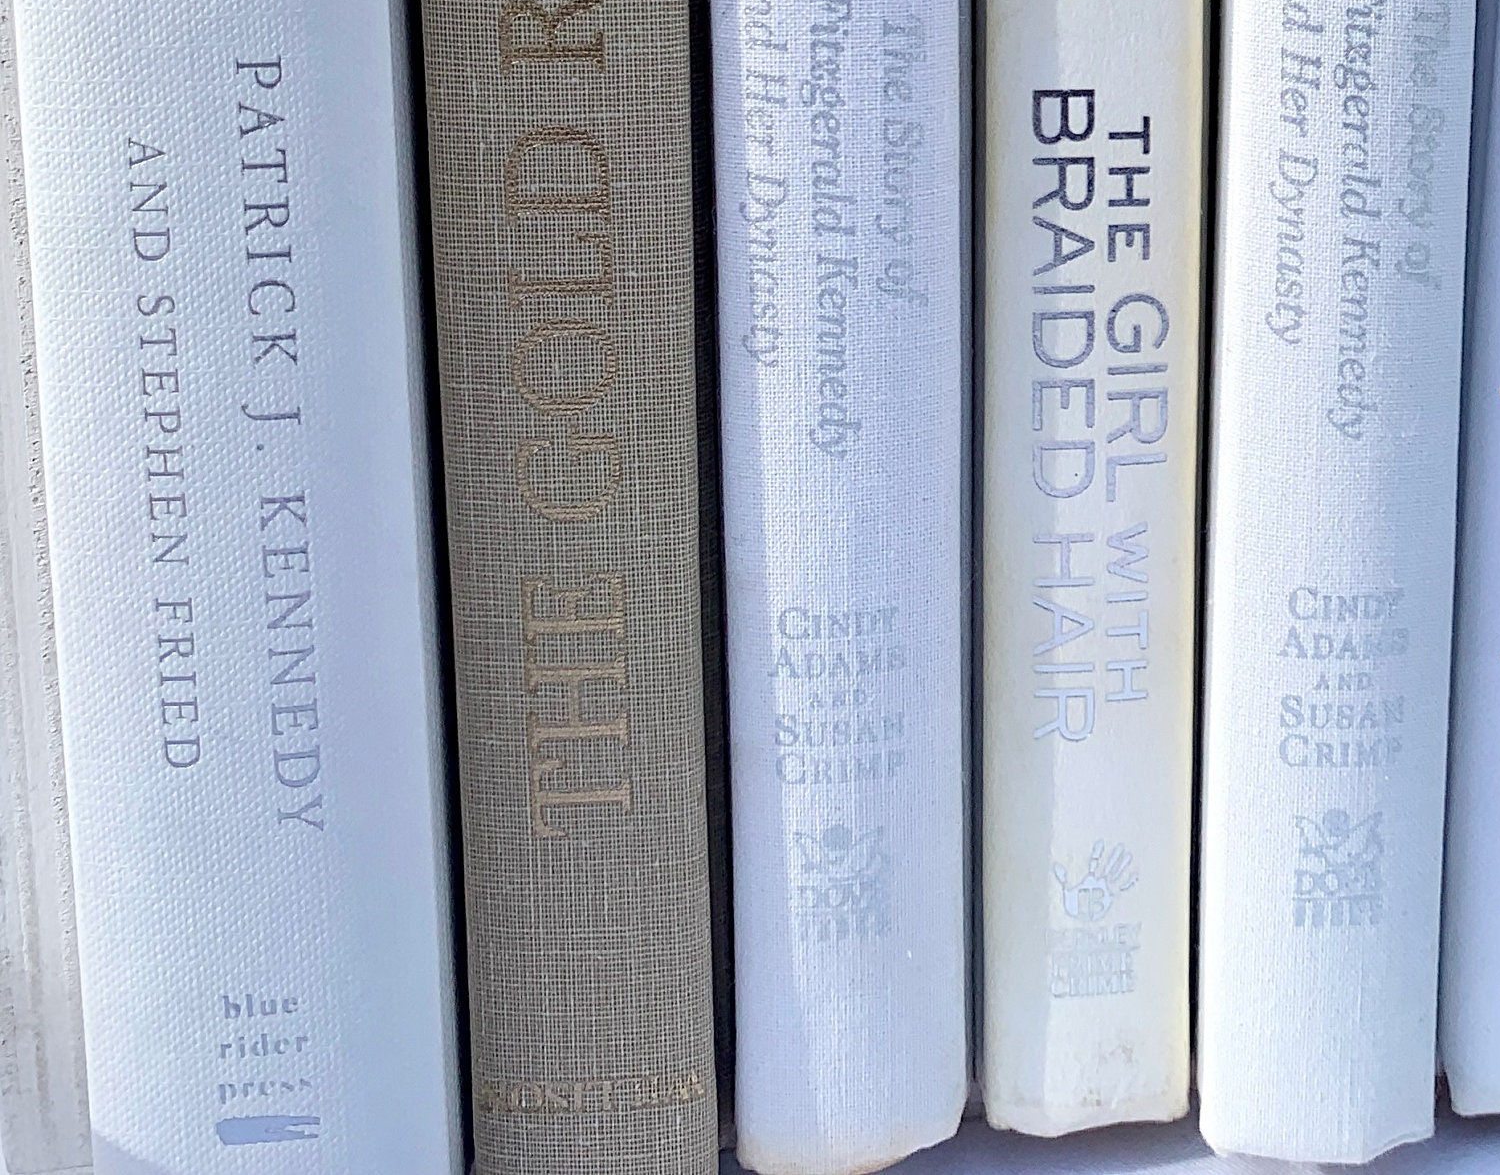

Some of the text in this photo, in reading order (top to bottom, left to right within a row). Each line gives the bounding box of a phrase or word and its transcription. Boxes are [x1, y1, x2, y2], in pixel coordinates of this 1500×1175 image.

[744, 69, 788, 157] Her
[874, 15, 929, 306] The Story of
[1280, 47, 1322, 138] Her
[1397, 2, 1450, 290] The Story of
[504, 125, 623, 523] GOLD
[738, 170, 787, 368] Dynasty
[1265, 147, 1319, 345] Dynasty
[1327, 236, 1381, 441] Kennedy
[128, 137, 201, 768] AND STEPHEN FRIED
[236, 56, 324, 832] PATRICK J. KENNEDY
[809, 254, 861, 459] Kennedy
[1032, 88, 1095, 742] BRAIDED HAIR
[1106, 115, 1169, 702] THE GIRL WITH
[521, 571, 632, 840] THE
[217, 1076, 313, 1105] press
[219, 1033, 309, 1060] rider
[222, 993, 300, 1019] blue
